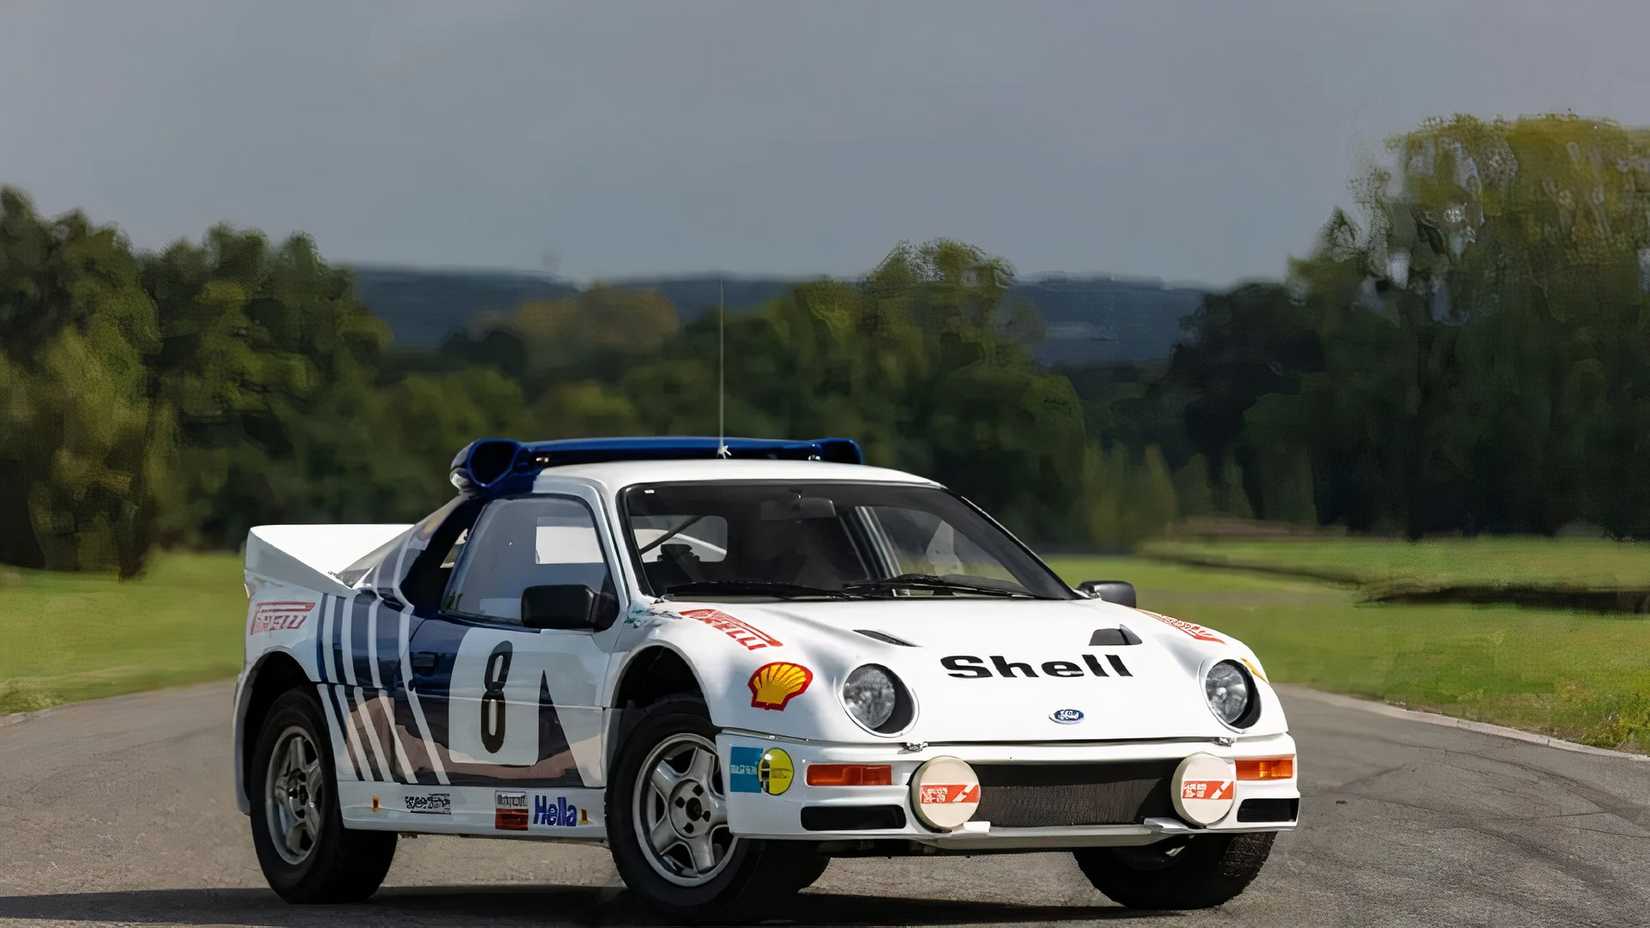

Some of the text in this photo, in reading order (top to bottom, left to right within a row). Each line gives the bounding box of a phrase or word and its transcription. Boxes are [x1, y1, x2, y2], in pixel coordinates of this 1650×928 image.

[251, 601, 316, 634] PELLI
[940, 654, 1134, 678] Shell
[481, 640, 513, 753] 8
[533, 795, 578, 827] Hella
